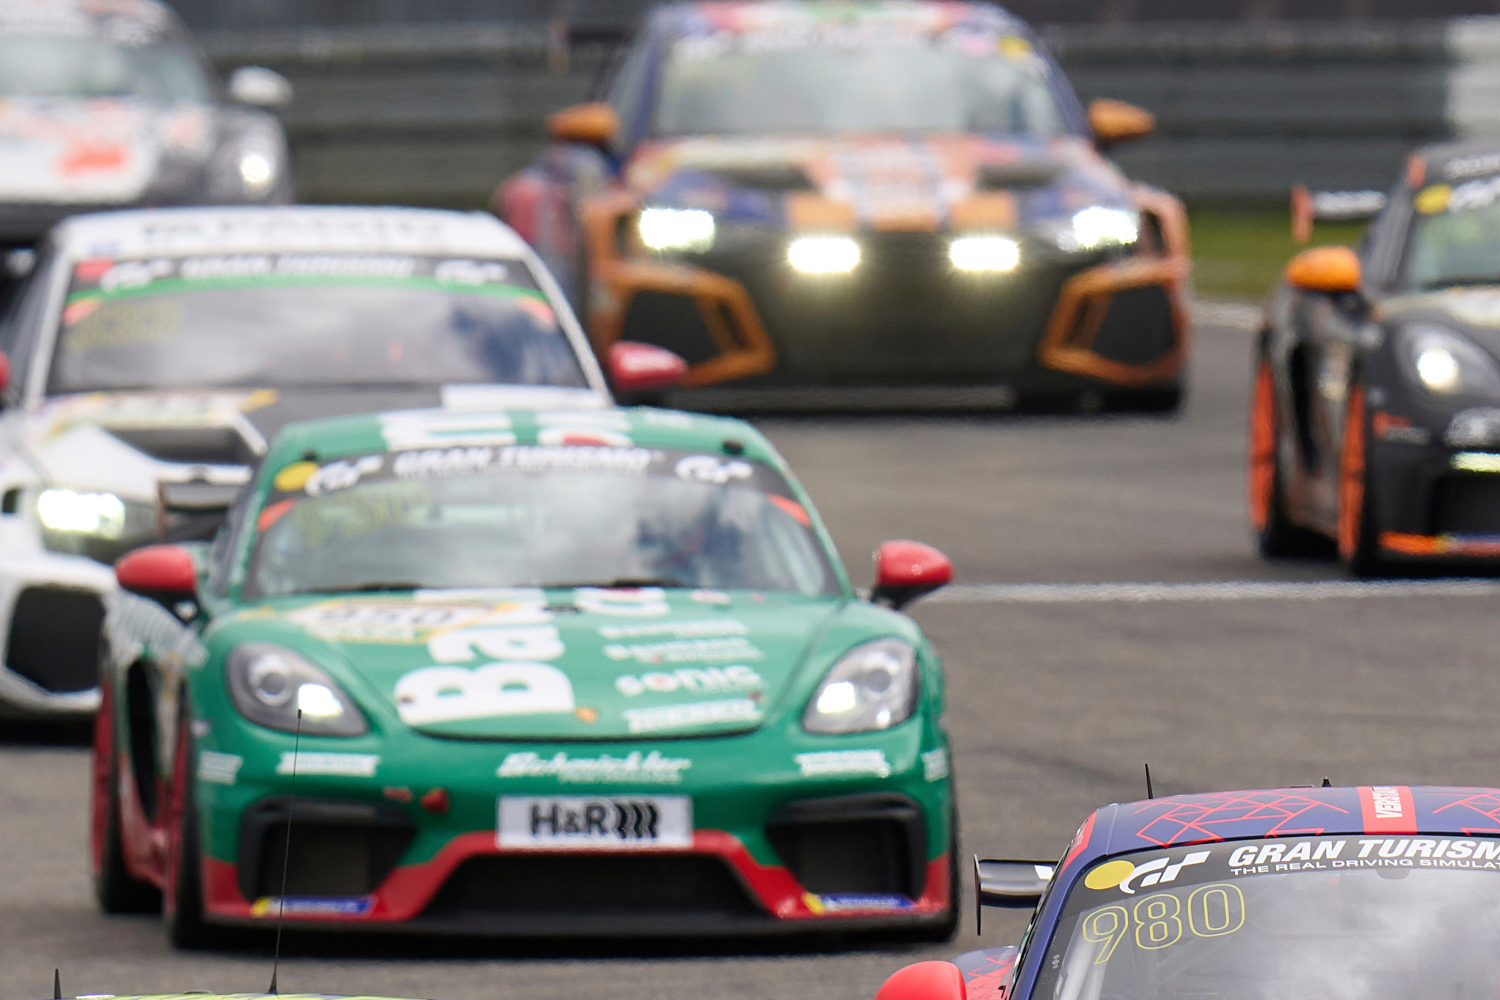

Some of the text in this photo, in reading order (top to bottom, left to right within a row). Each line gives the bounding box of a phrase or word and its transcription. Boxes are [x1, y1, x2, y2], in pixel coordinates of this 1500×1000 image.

[392, 447, 492, 473] GRAN
[531, 803, 611, 839] H&R
[1228, 840, 1347, 868] GRAN
[1229, 865, 1270, 876] THE
[1275, 862, 1328, 873] REAL
[1332, 859, 1414, 869] DRIVING
[1082, 883, 1246, 965] 980
